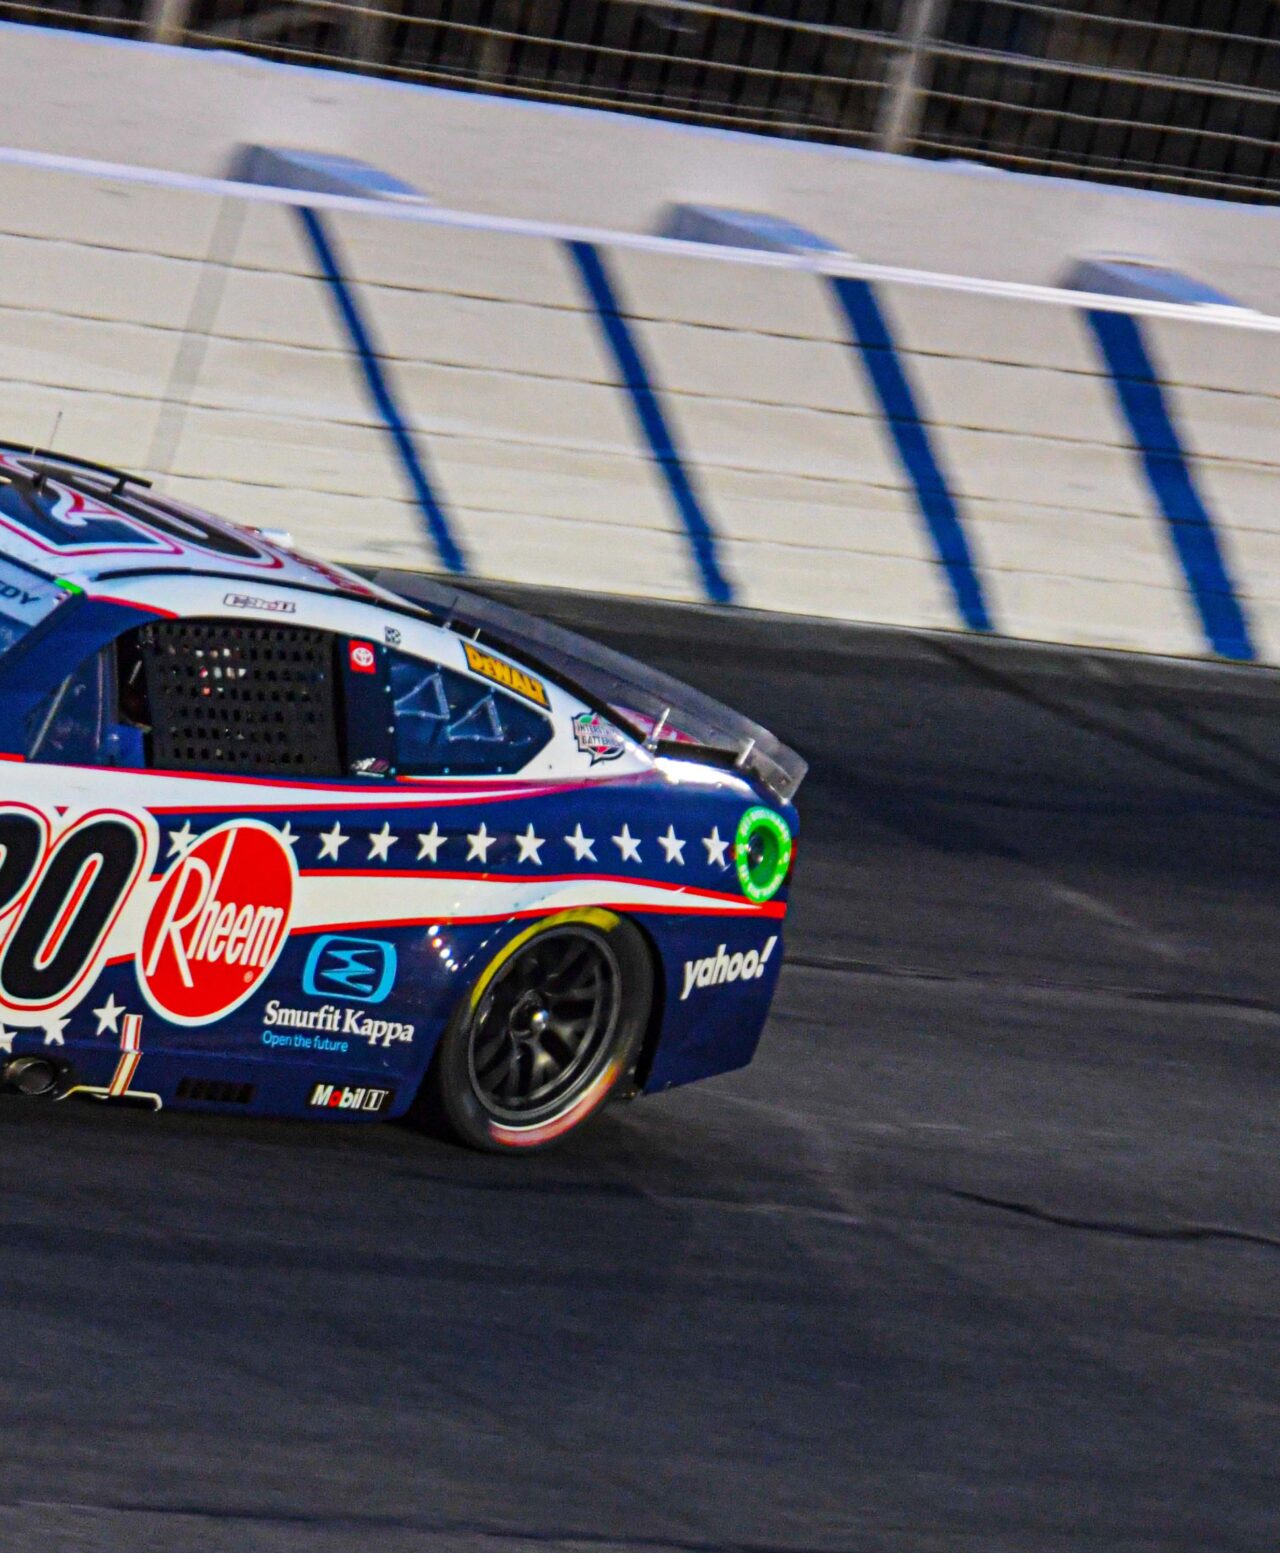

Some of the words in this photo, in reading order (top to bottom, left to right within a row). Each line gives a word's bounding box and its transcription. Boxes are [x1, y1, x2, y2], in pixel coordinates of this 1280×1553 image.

[145, 827, 285, 988] Rheem
[680, 935, 778, 1000] yahoo!
[262, 1030, 293, 1048] Open
[294, 1035, 312, 1048] the
[313, 1036, 349, 1052] future
[263, 1000, 342, 1033] Smurfit
[341, 1008, 416, 1047] Kappa
[310, 1083, 366, 1109] Mobil
